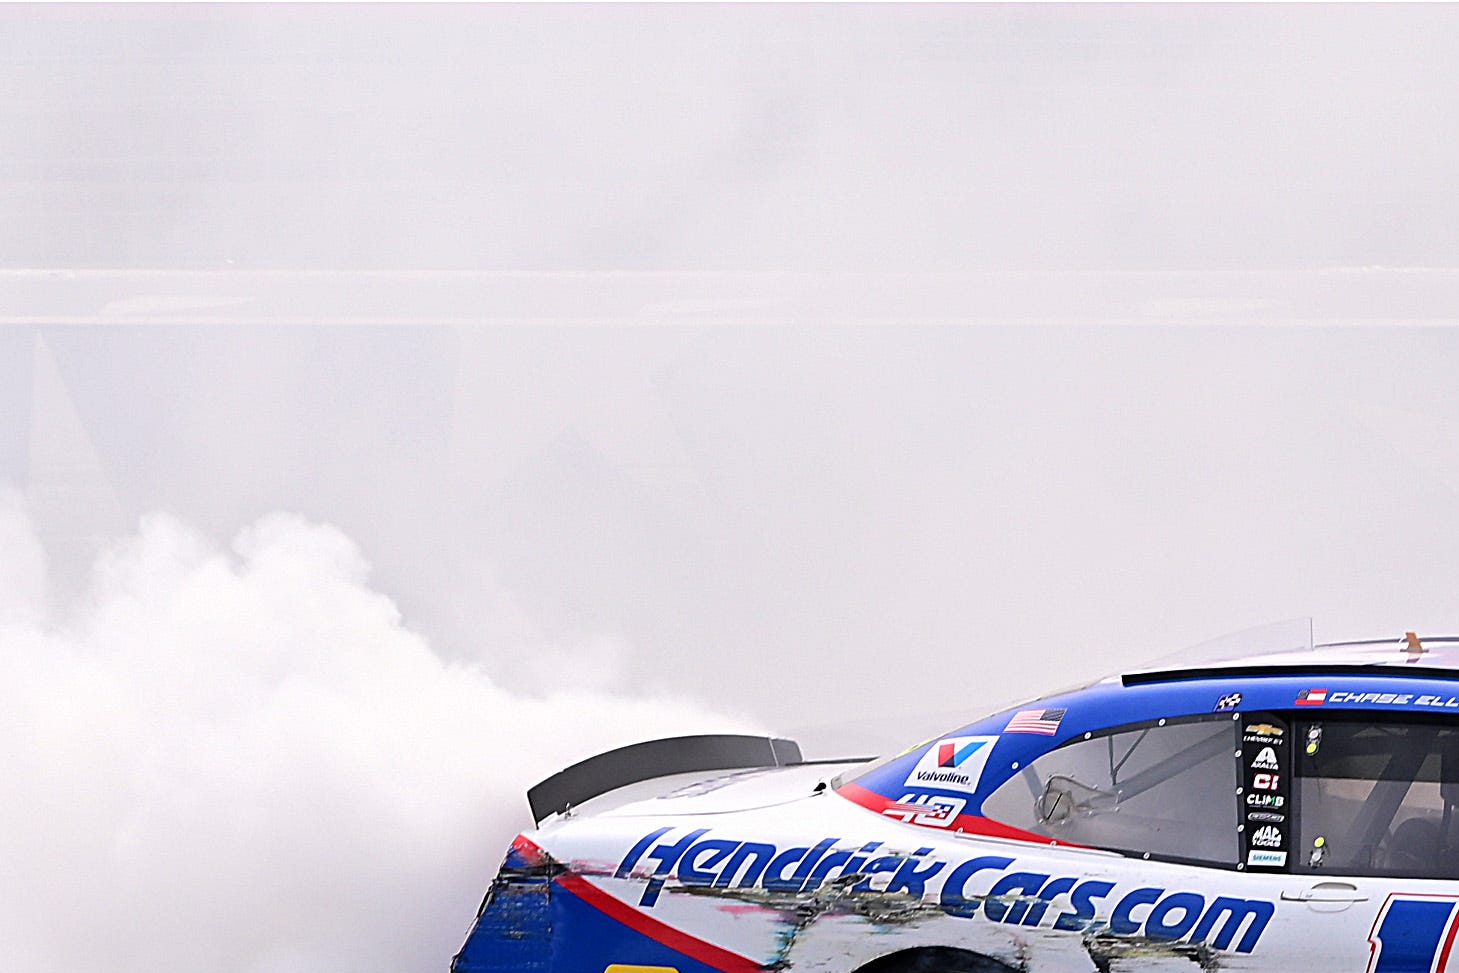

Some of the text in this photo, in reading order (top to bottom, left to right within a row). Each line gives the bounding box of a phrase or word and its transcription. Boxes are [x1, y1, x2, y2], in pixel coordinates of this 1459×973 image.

[1328, 692, 1414, 705] CHASE
[917, 771, 968, 785] Valvoline
[1252, 825, 1282, 841] MAC
[1252, 839, 1281, 847] TOOLS
